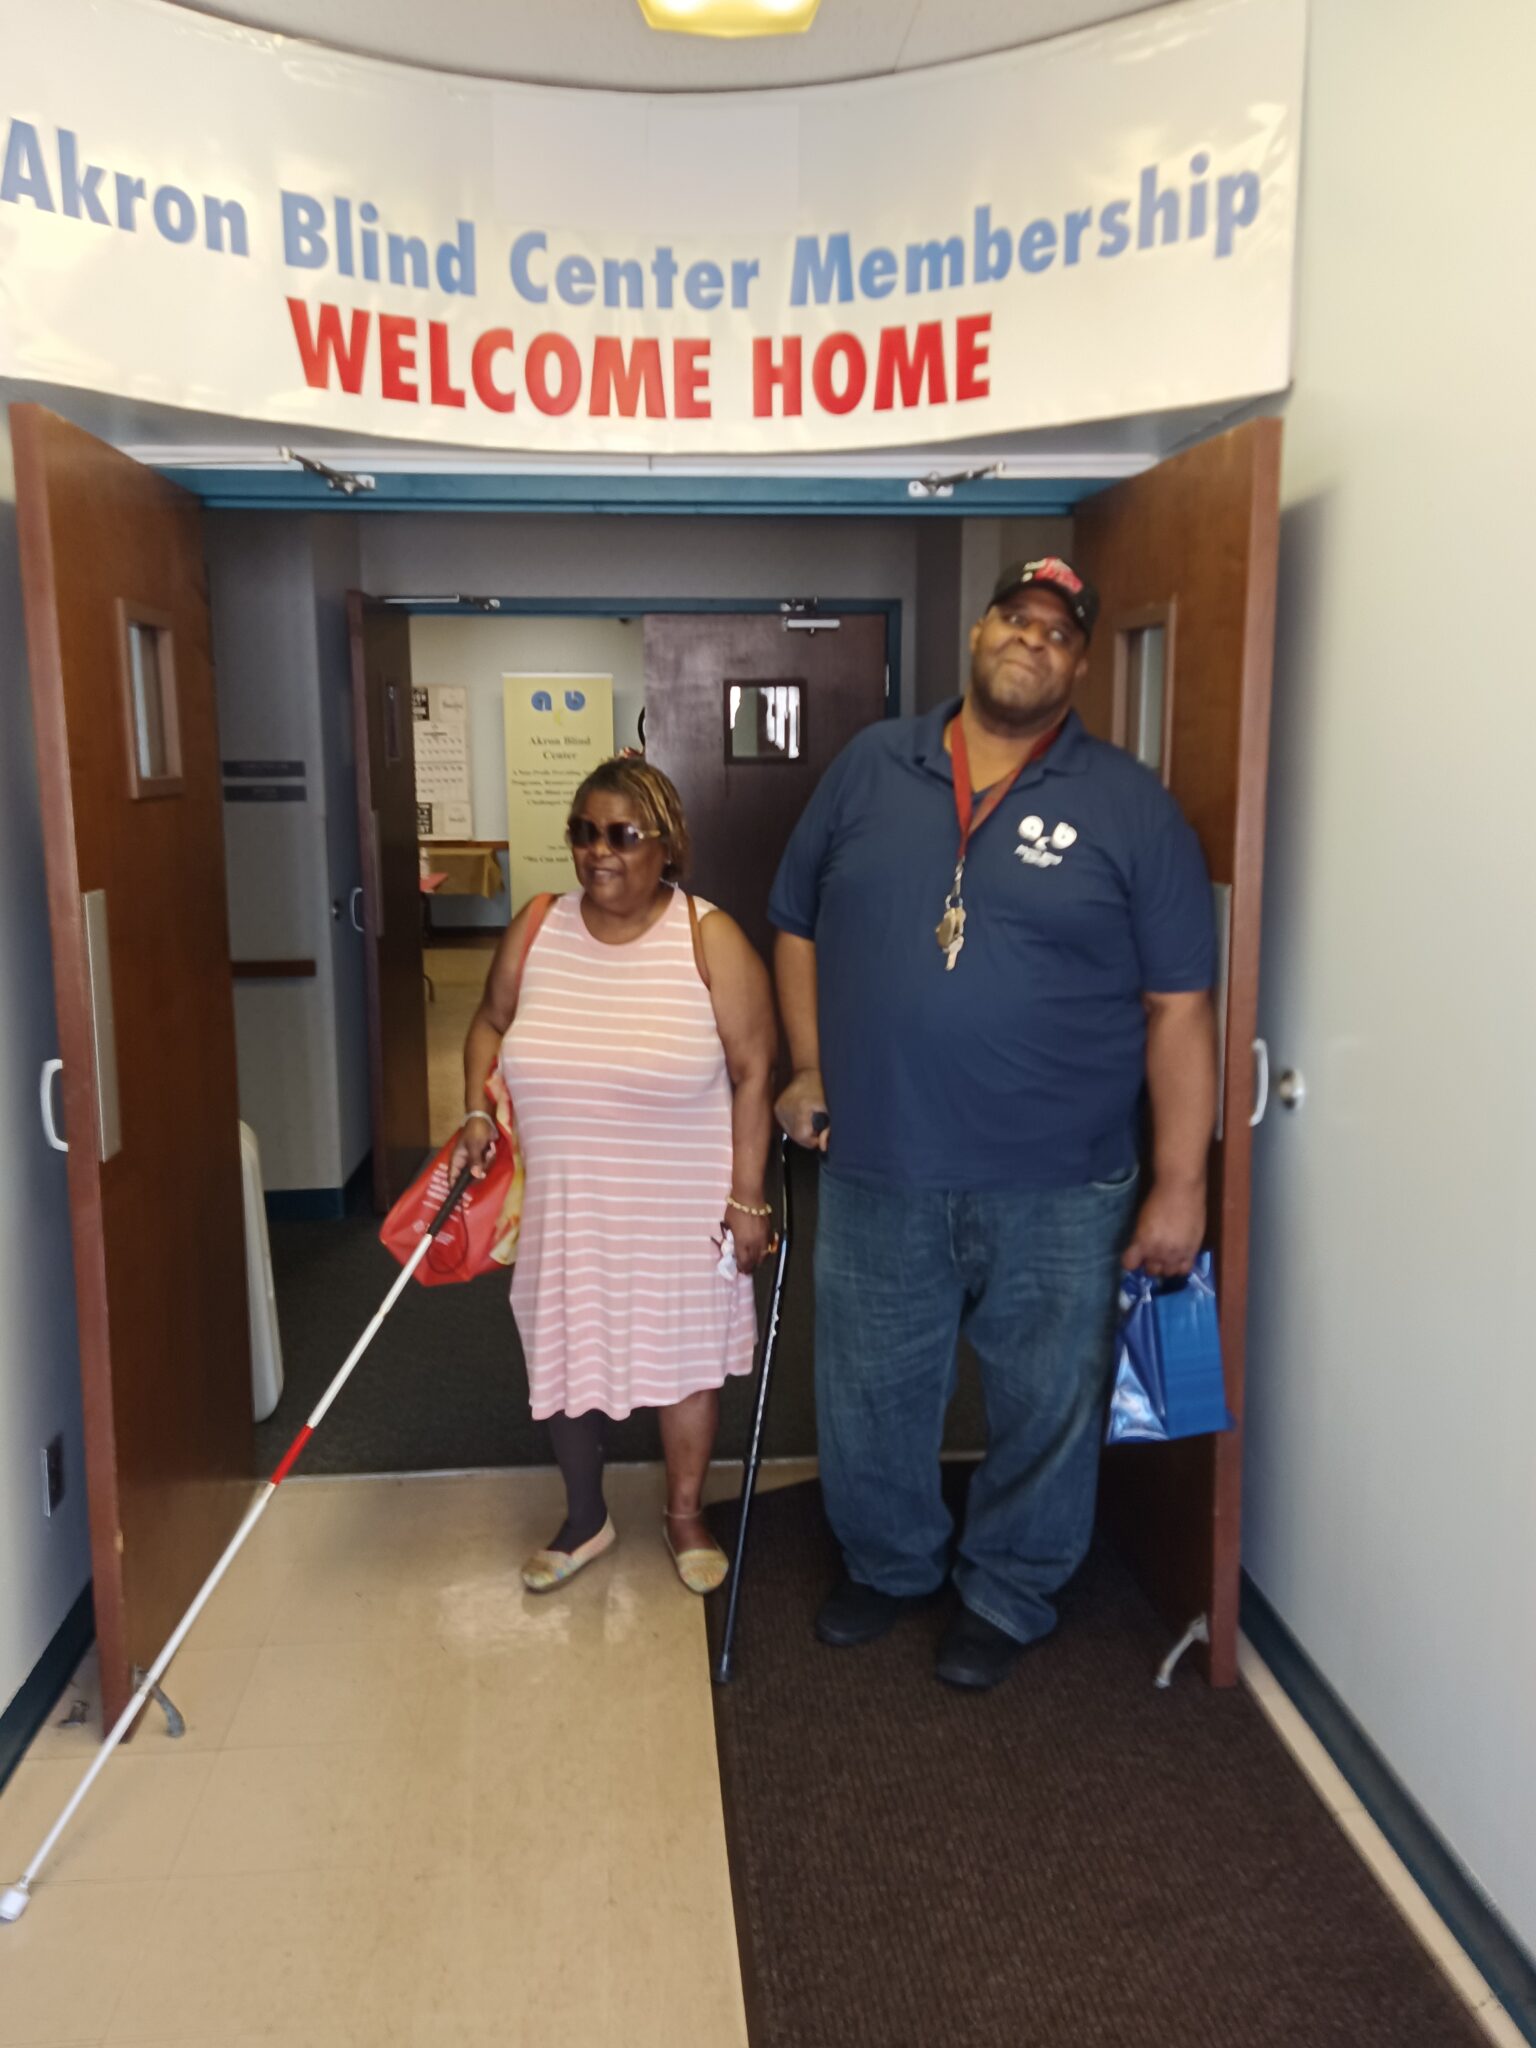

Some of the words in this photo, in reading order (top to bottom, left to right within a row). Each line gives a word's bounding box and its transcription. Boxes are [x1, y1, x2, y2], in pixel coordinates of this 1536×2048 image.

[0, 117, 249, 257] Akron
[280, 189, 477, 296] Blind
[509, 231, 760, 310] Center
[789, 150, 1261, 307] Membership
[286, 295, 712, 420] WELCOME
[752, 312, 993, 419] HOME
[529, 735, 561, 746] Akron
[563, 734, 591, 746] Blind
[542, 750, 577, 761] Center
